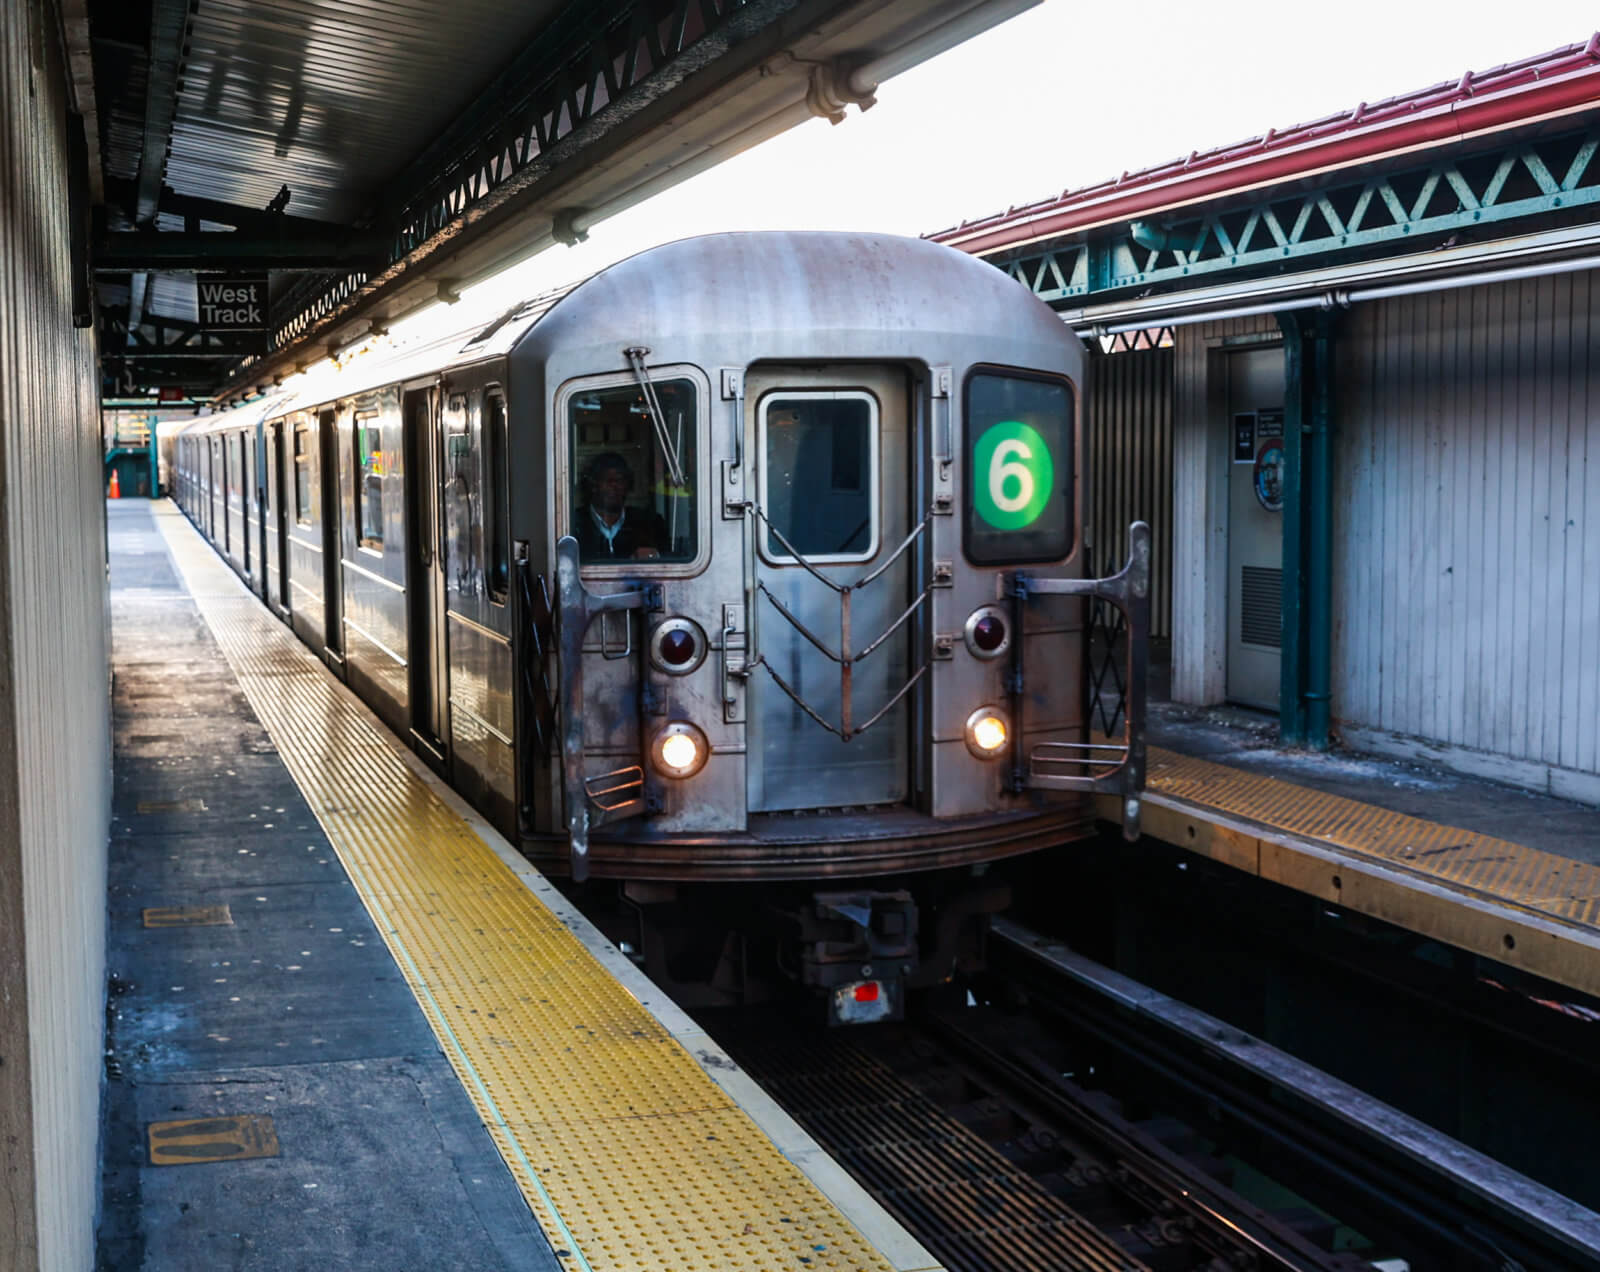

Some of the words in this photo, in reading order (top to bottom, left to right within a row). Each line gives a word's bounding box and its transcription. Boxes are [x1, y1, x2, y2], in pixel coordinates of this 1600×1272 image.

[201, 284, 257, 303] West
[201, 304, 261, 323] Track
[989, 439, 1034, 512] 6
